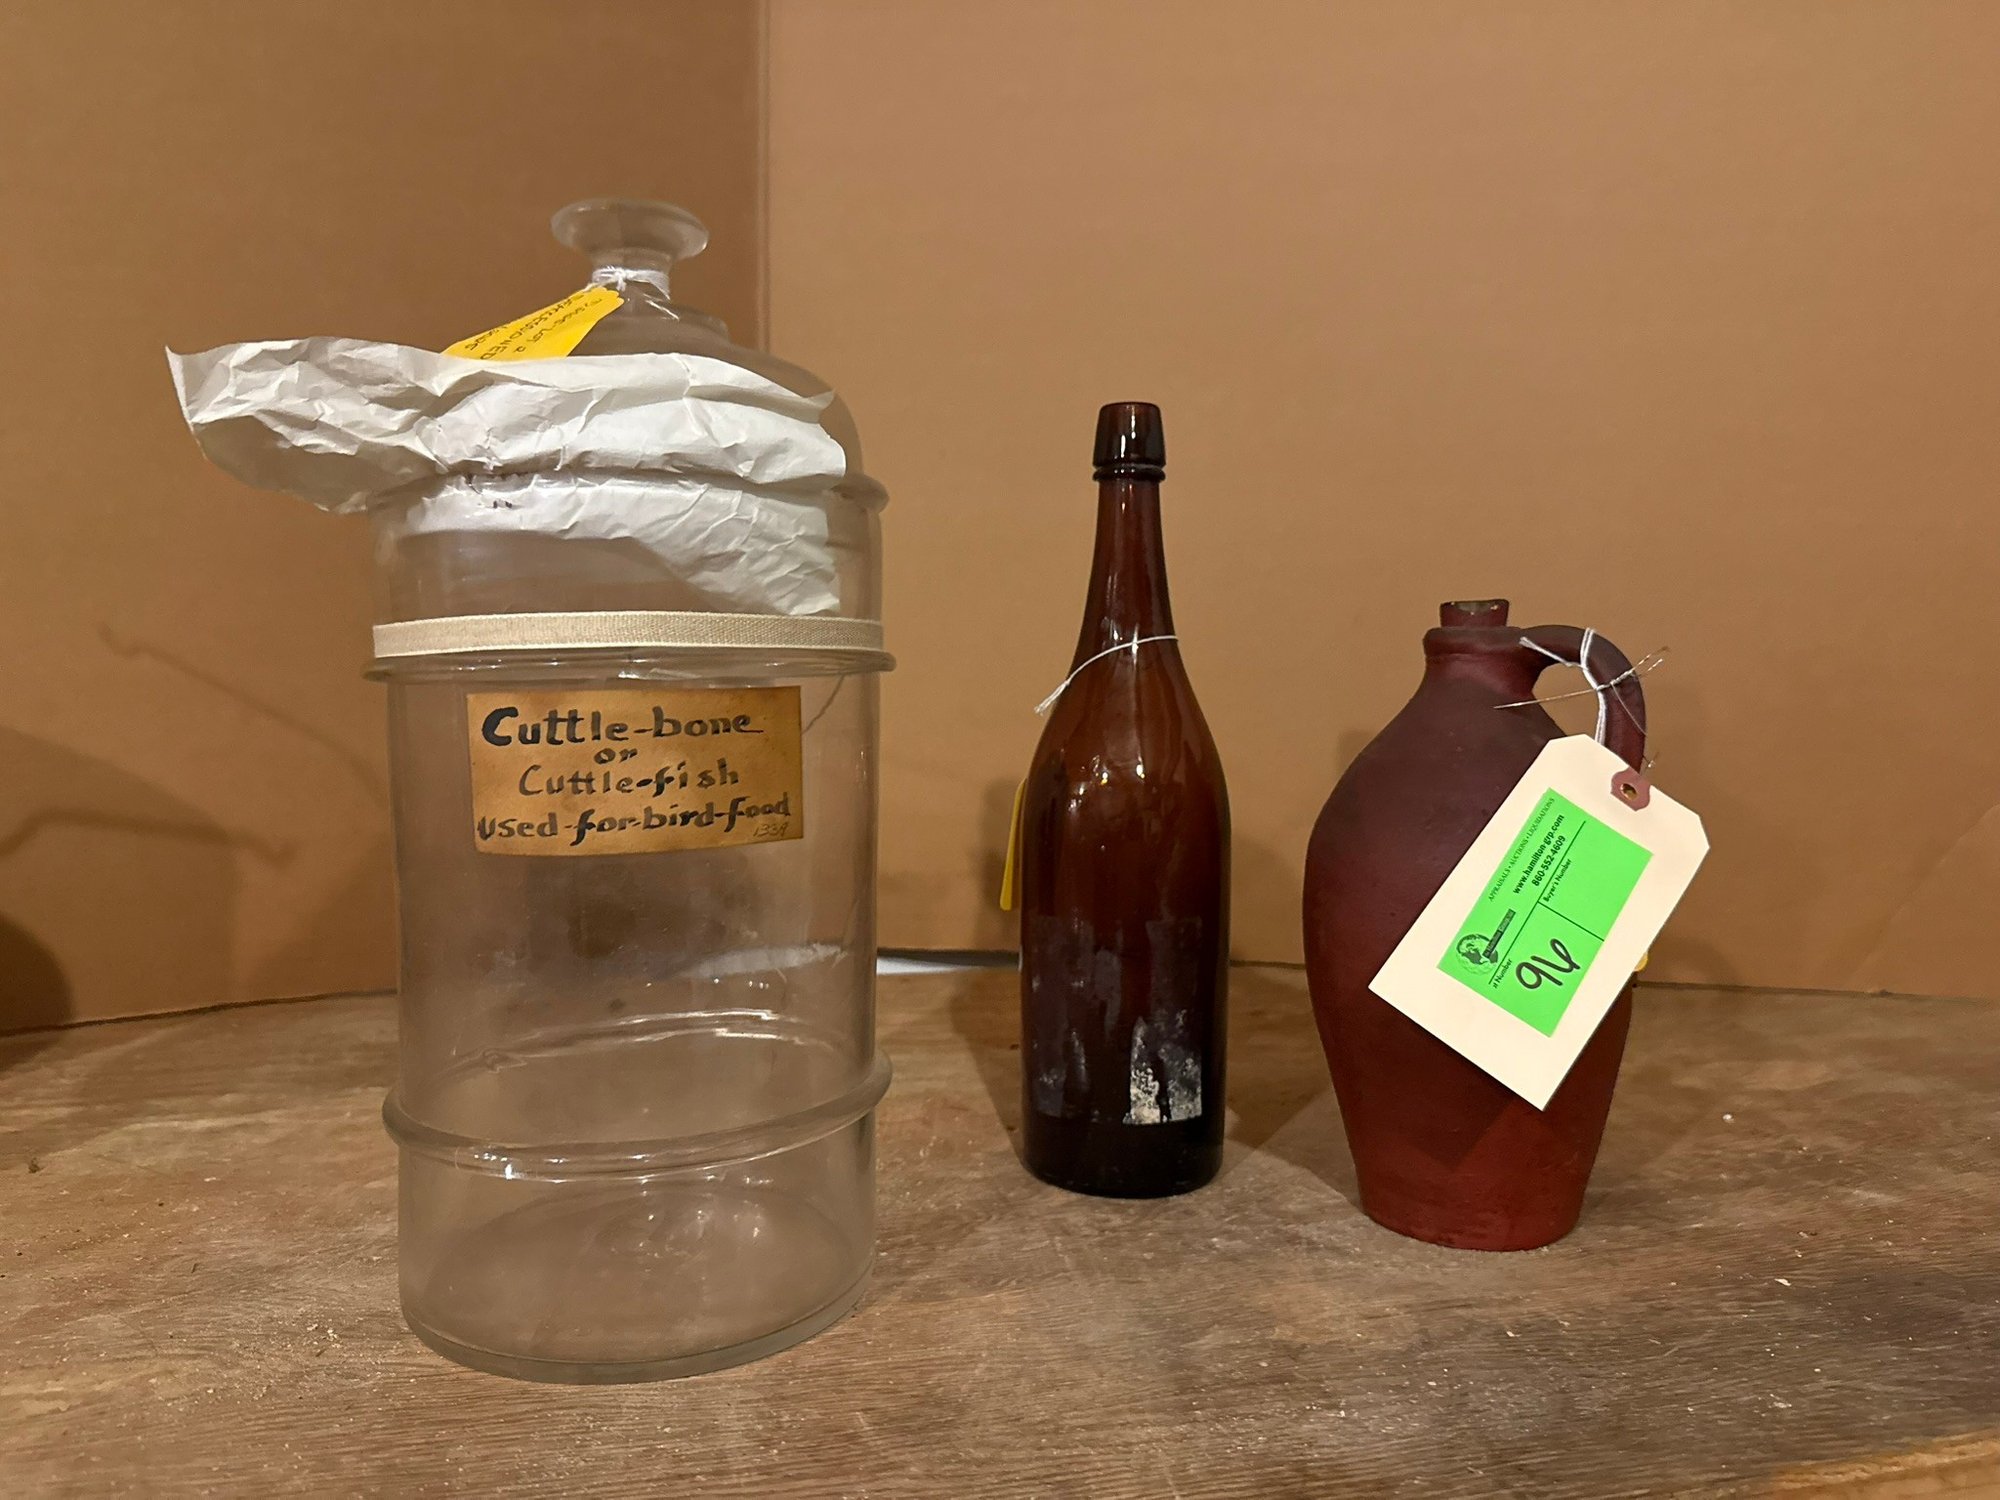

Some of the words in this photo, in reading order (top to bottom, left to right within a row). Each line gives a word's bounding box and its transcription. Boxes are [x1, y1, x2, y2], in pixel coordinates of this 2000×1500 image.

[482, 706, 764, 746] Cuttle-bone
[519, 757, 739, 796] Cuttle-fish
[594, 747, 637, 764] or
[1488, 869, 1511, 902] APPRAISALS
[1509, 839, 1529, 866] AUCTIONS
[1527, 798, 1555, 837] LIQUIDATIONS
[1513, 814, 1565, 894] www.hamilton-grp.com
[1531, 835, 1566, 886] 860-552-4609
[1543, 881, 1559, 902] Buyer's
[1555, 858, 1571, 882] Number
[1495, 959, 1512, 981] Number
[1516, 938, 1580, 989] 96
